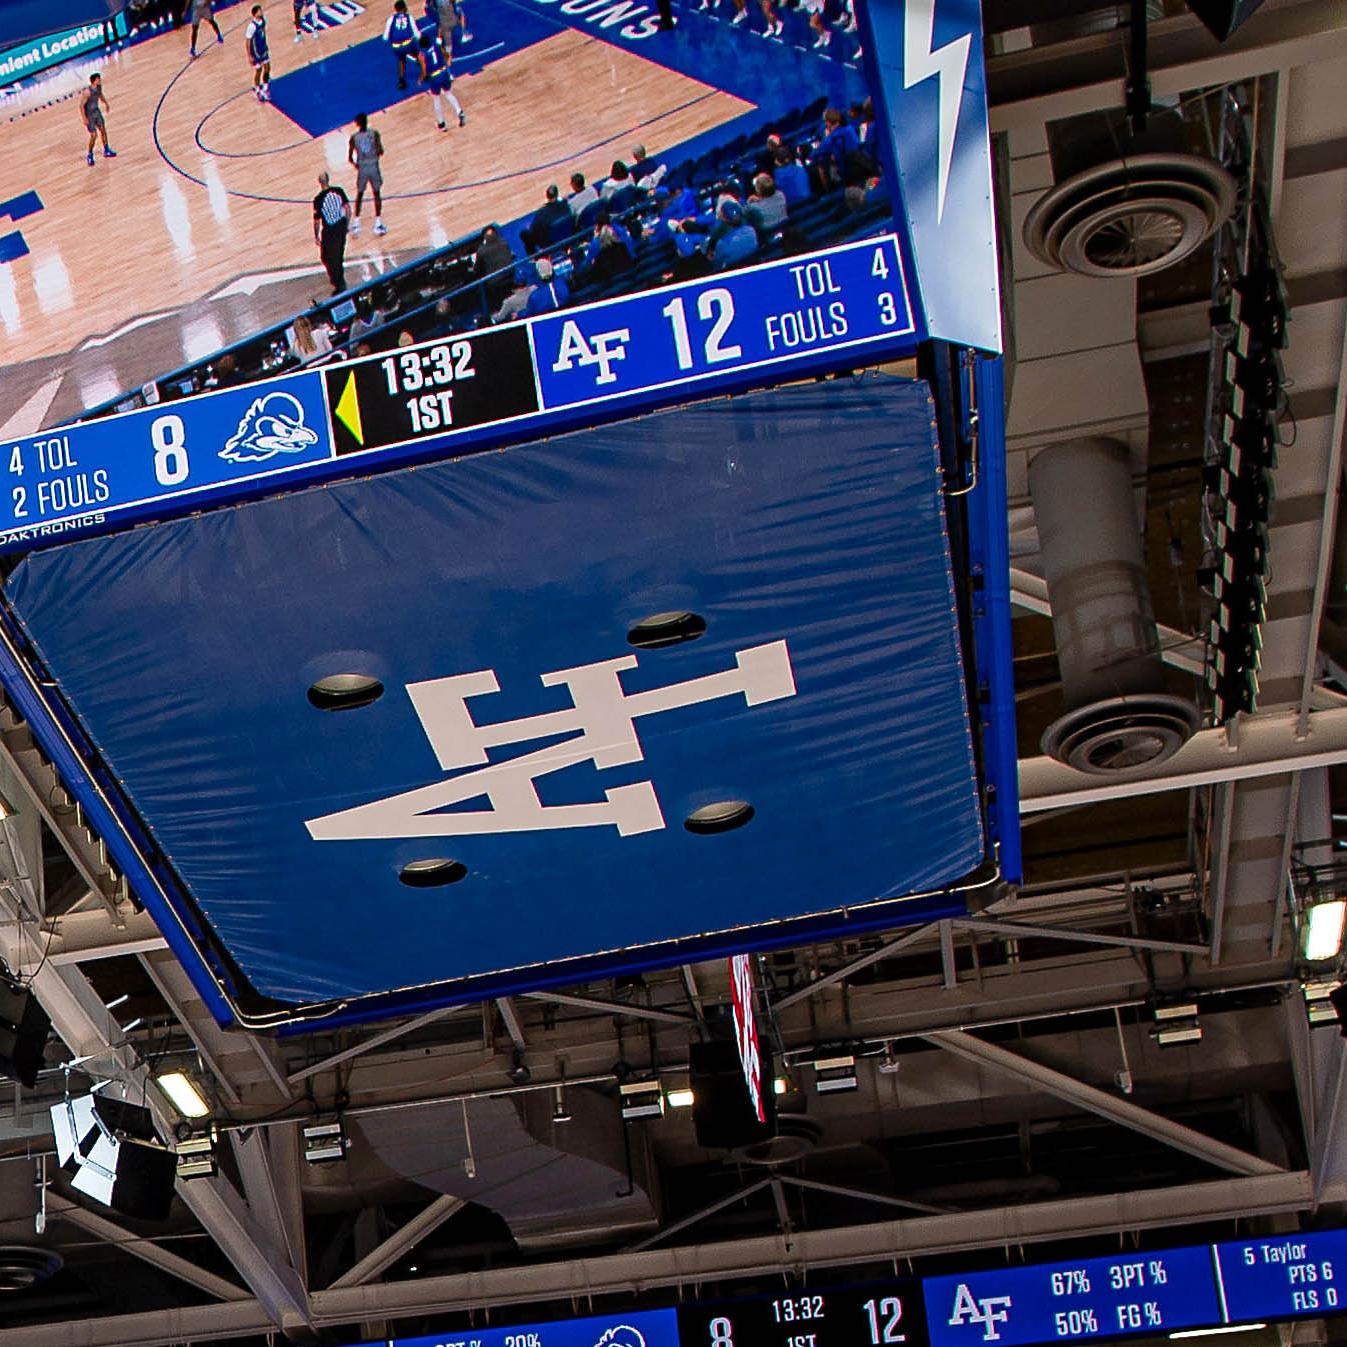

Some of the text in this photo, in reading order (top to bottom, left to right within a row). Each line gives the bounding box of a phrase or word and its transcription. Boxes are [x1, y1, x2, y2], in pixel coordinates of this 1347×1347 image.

[790, 248, 889, 299] TOL 4
[553, 288, 742, 385] AF 12
[766, 299, 897, 351] FOULS 3
[382, 341, 475, 395] 13:32
[407, 394, 454, 432] 1ST
[8, 440, 77, 476] 4 TOL
[151, 415, 190, 486] 8
[13, 468, 109, 518] 2 FOULS
[305, 640, 797, 841] AF
[1244, 1241, 1306, 1265] 5 Taylor
[1289, 1261, 1333, 1283] PTS 6
[1051, 1262, 1167, 1296] 67% 3PT %
[1293, 1287, 1337, 1310] FLS 0
[772, 1296, 824, 1322] 13:32
[863, 1297, 906, 1345] 12
[948, 1283, 1011, 1341] AF
[1055, 1302, 1161, 1336] 50% FG %
